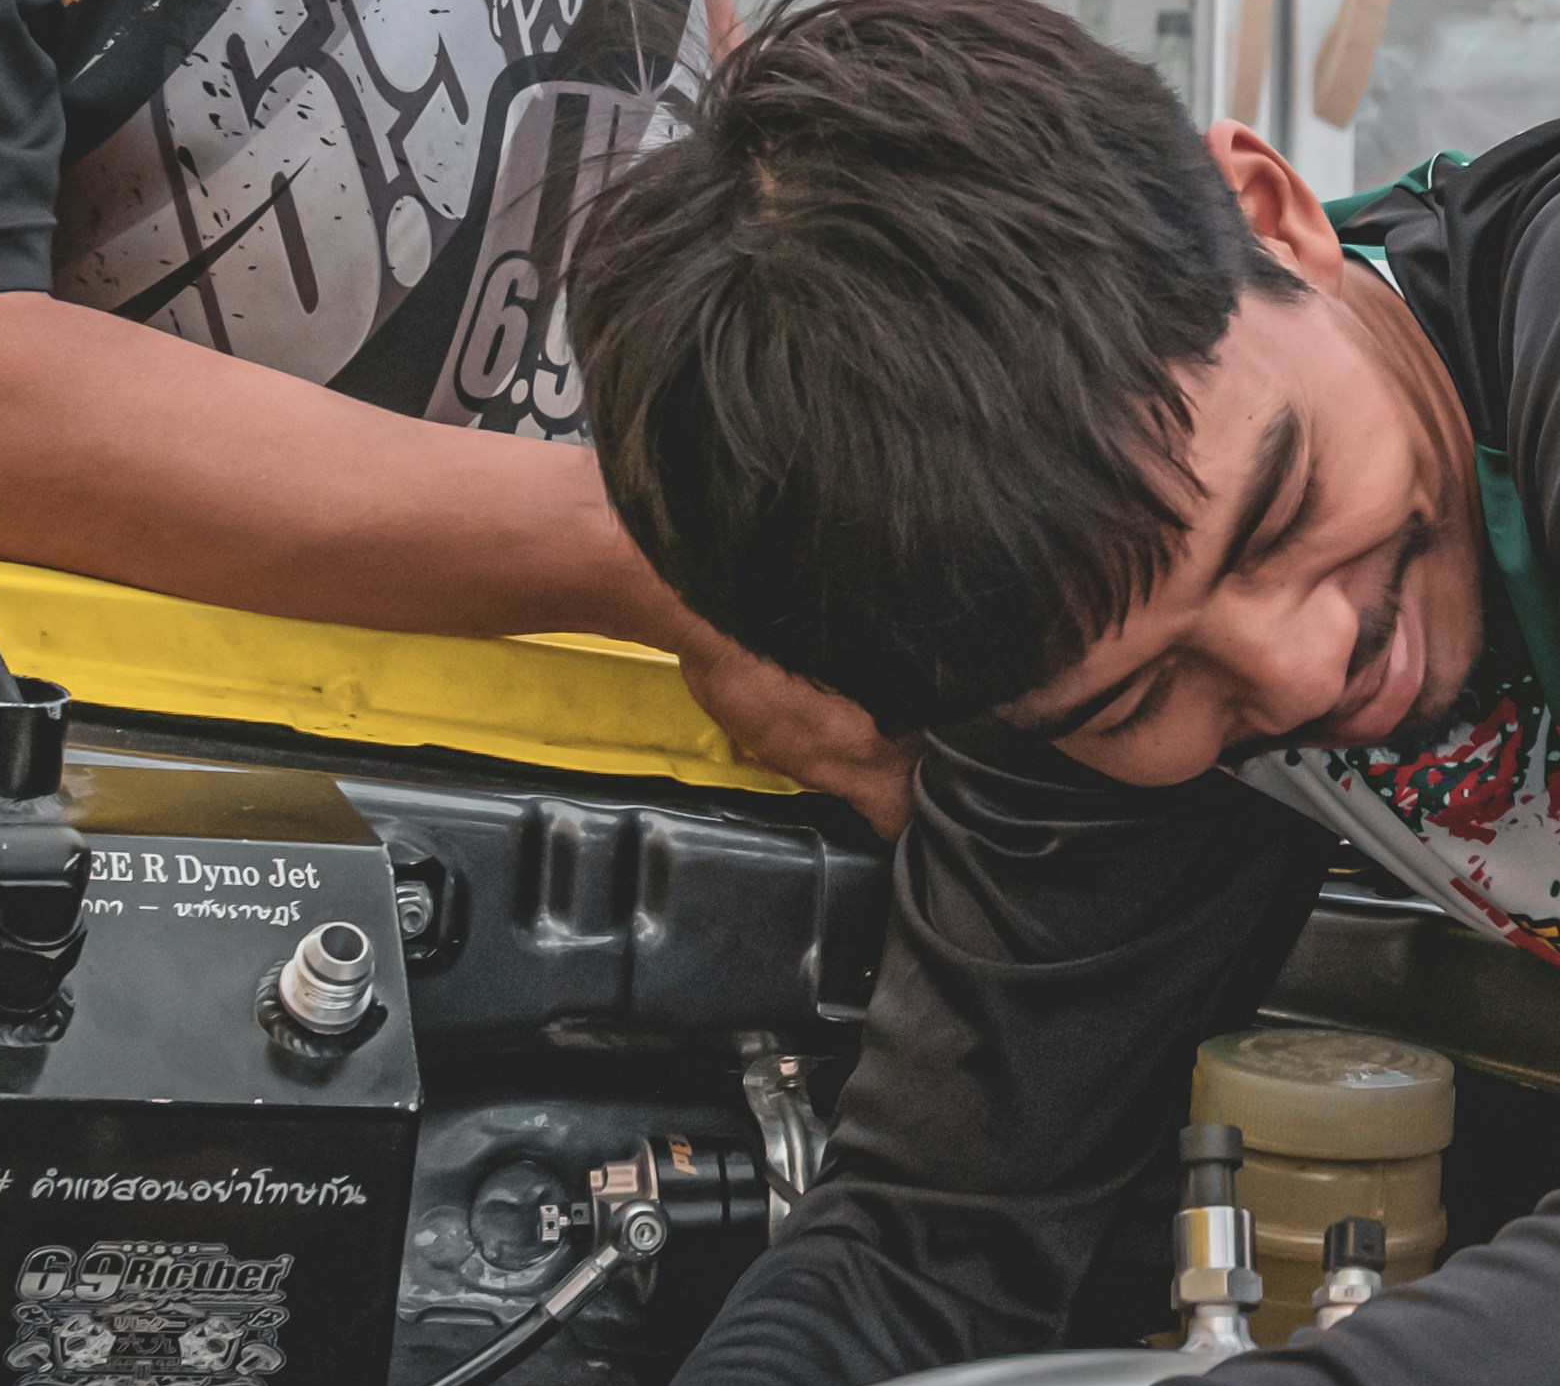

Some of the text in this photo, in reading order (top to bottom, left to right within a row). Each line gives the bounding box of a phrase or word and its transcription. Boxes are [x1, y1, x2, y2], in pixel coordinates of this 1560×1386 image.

[142, 852, 169, 885] R
[174, 854, 261, 892] Dyno
[267, 857, 321, 890] Jet
[16, 1245, 126, 1302] 6.9
